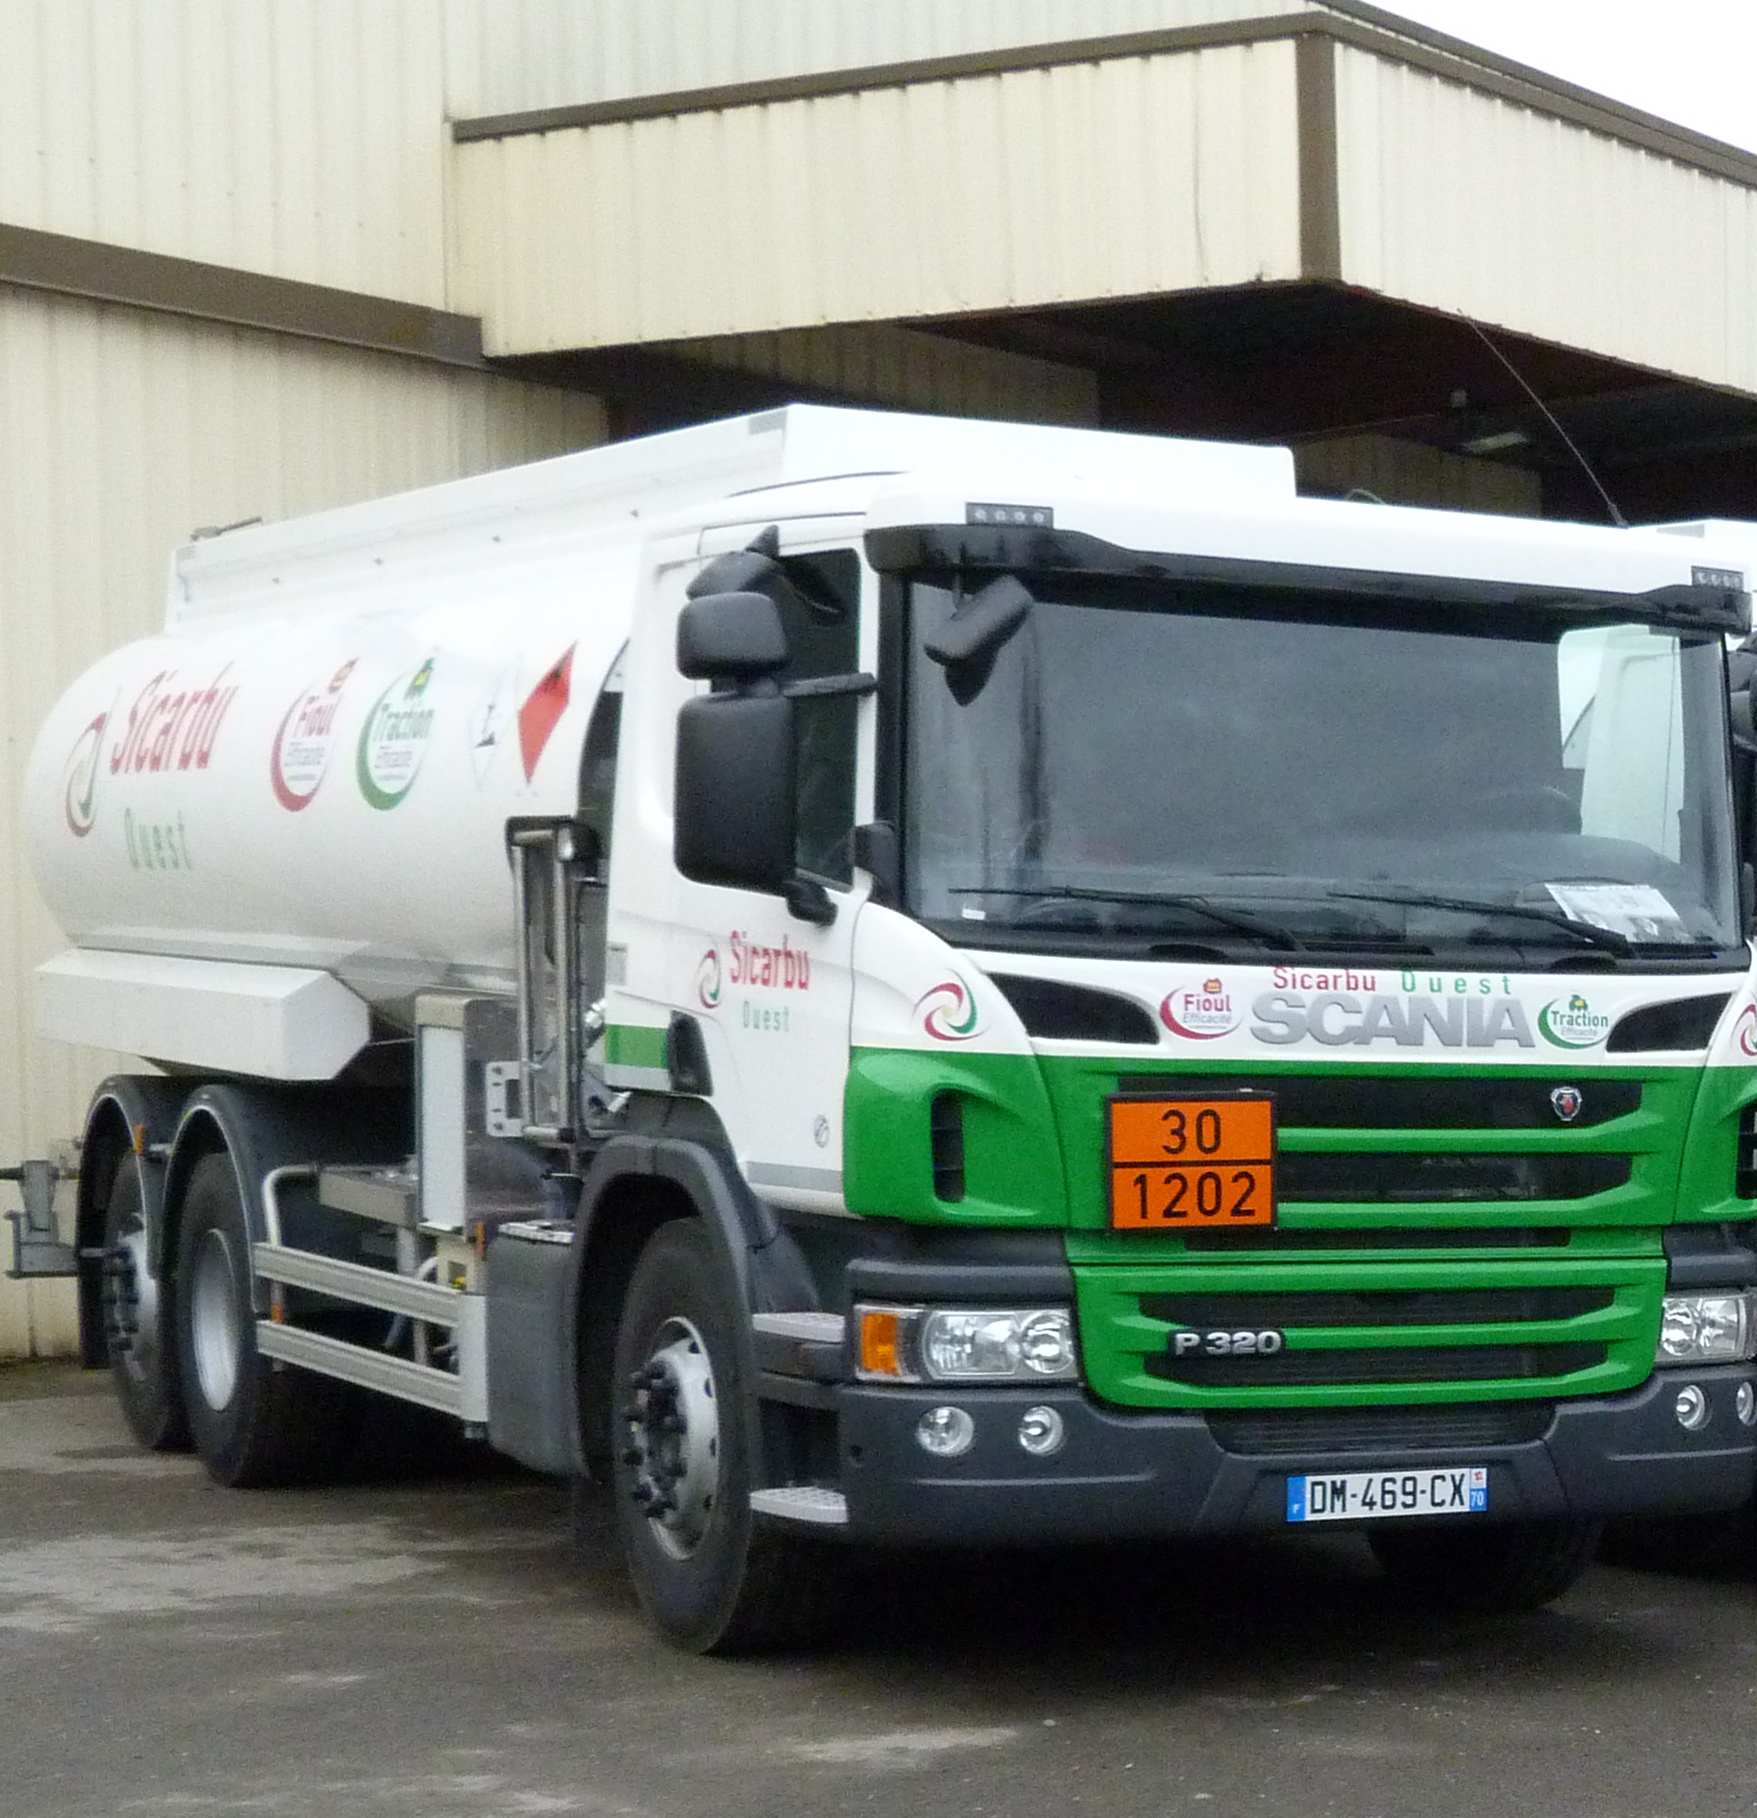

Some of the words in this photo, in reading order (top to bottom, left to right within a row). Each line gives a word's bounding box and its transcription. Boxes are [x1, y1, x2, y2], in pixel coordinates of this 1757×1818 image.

[110, 661, 240, 775] Sicarbu
[124, 807, 192, 870] Ouest
[729, 930, 809, 990] Sicarbu
[1273, 967, 1376, 991] Sicarbu
[1401, 971, 1512, 995] Ouest
[742, 1000, 790, 1032] Ouest
[1183, 1012, 1232, 1025] Efficacité
[1184, 994, 1232, 1012] Fioul
[1250, 991, 1536, 1048] SCANIA
[1551, 1011, 1609, 1028] Traction
[1161, 1109, 1221, 1154] 30
[1133, 1171, 1256, 1219] 1202
[1175, 1333, 1200, 1355] P
[1206, 1331, 1281, 1354] 320
[1310, 1474, 1465, 1514] DM-469-CX
[1470, 1491, 1484, 1507] 70
